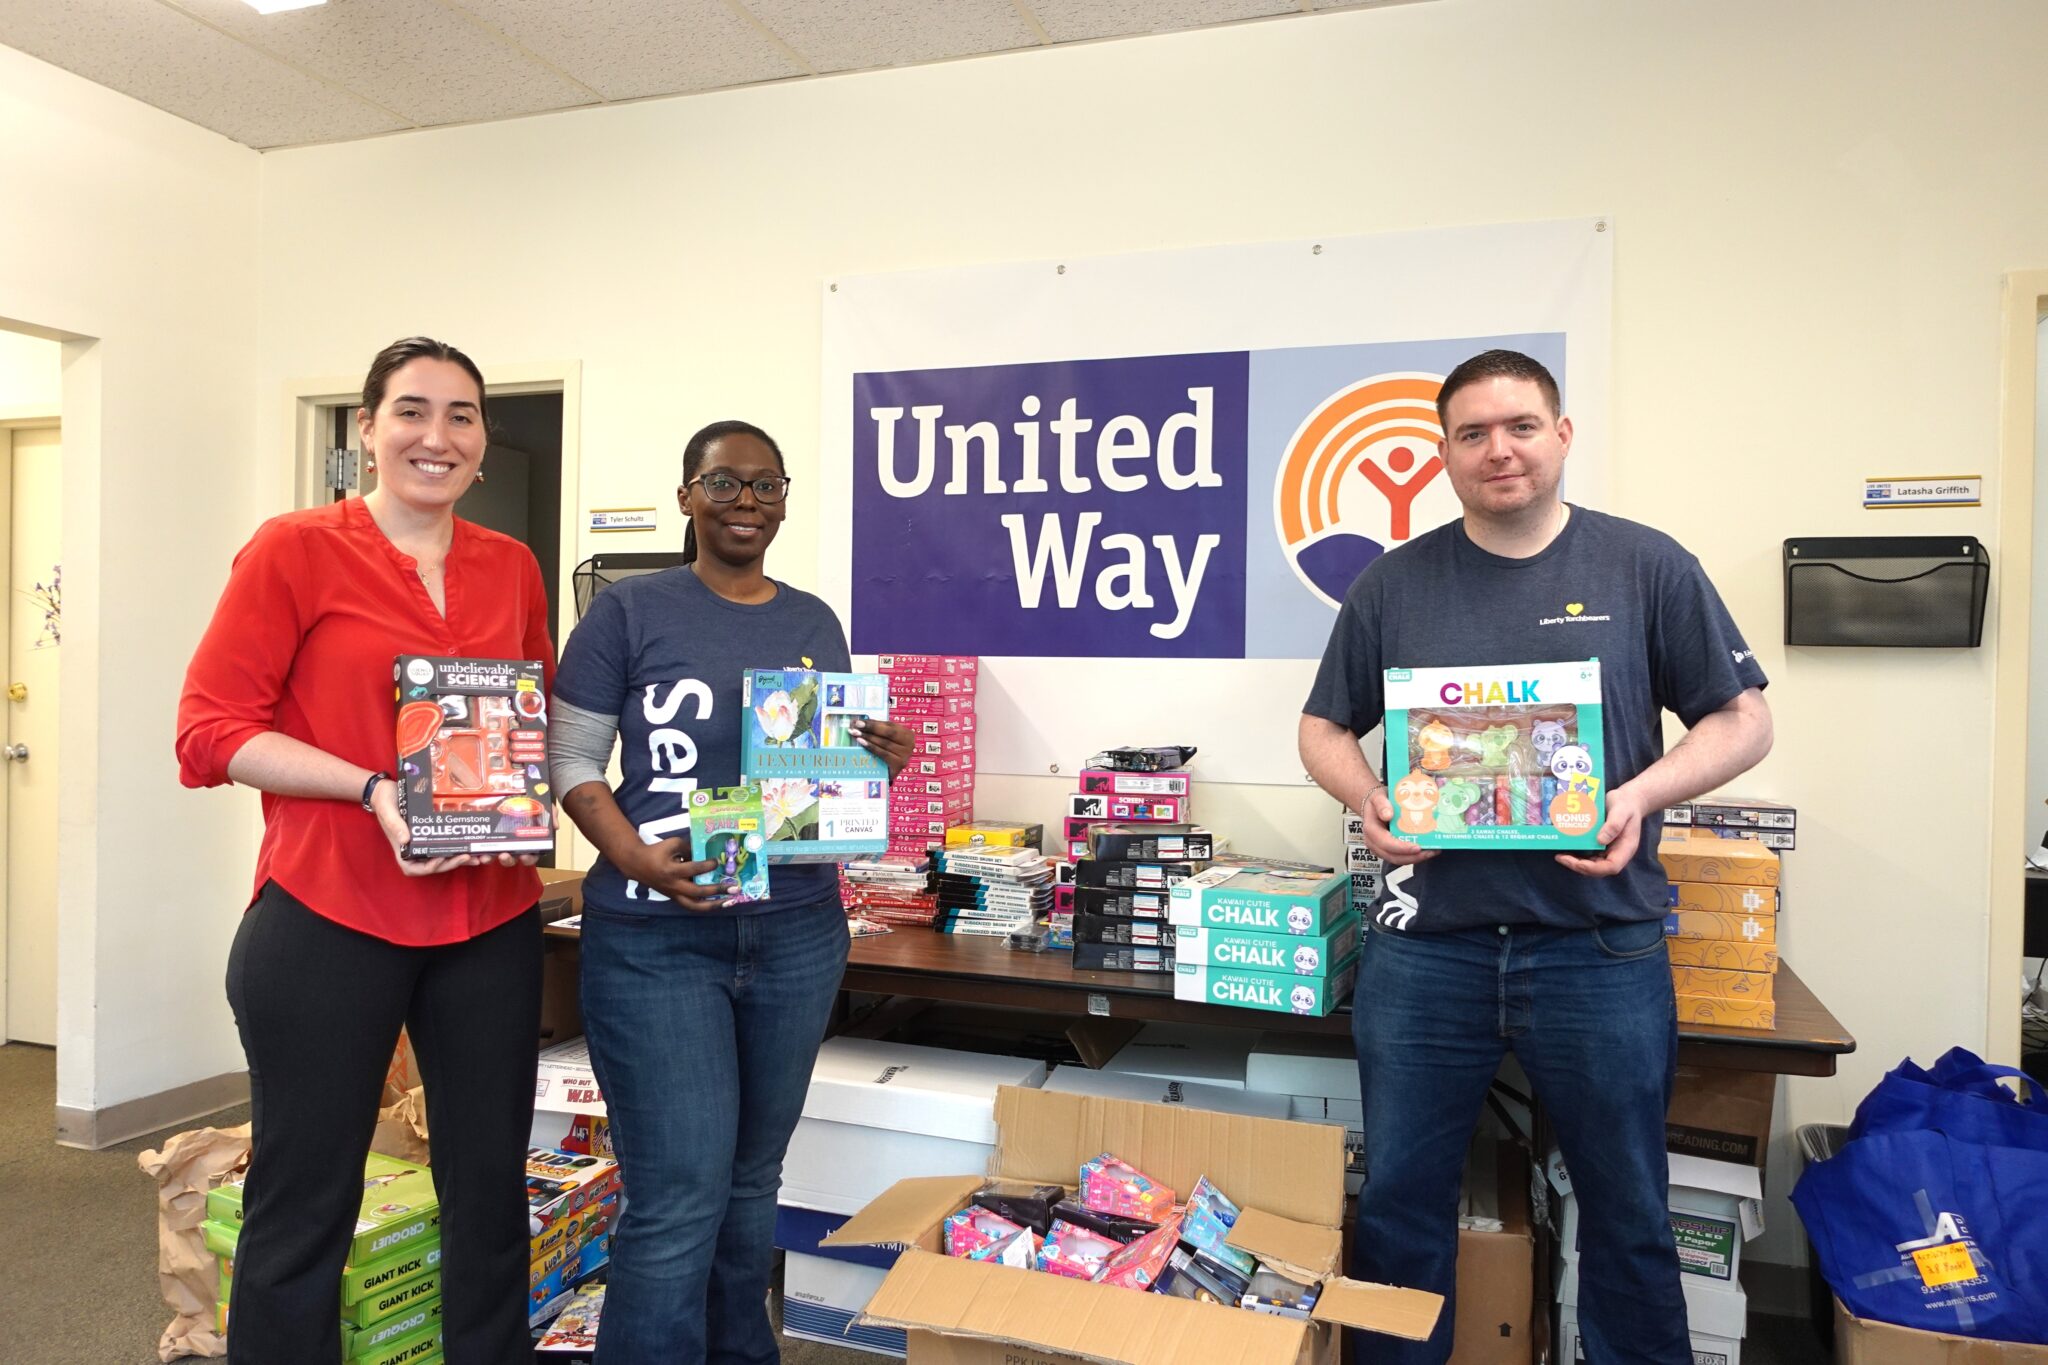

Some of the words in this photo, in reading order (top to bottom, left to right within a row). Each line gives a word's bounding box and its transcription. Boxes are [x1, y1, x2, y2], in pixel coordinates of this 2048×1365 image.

[870, 385, 1222, 499] United
[1897, 487, 1933, 496] Latasha
[1935, 486, 1970, 495] Griffith
[1001, 511, 1220, 640] Way
[1539, 617, 1565, 625] Liberty
[439, 662, 516, 676] unbelievable
[447, 673, 508, 686] SCIENCE
[1439, 679, 1541, 705] CHALK
[757, 753, 846, 769] TEXTURED
[850, 754, 878, 769] ART
[626, 678, 714, 901] Serv
[1074, 797, 1102, 816] MTV
[1566, 794, 1581, 813] 5
[412, 815, 434, 824] Rock
[435, 816, 443, 824] &
[445, 815, 491, 823] Gemstone
[1555, 813, 1591, 823] BONUS
[411, 825, 491, 836] COLLECTION
[825, 820, 834, 838] 1
[840, 818, 879, 826] PRINTED
[1352, 854, 1379, 862] WARS
[1217, 897, 1245, 905] KAWAII
[1246, 899, 1271, 908] CUTIE
[1207, 904, 1280, 927] CHALK
[1223, 937, 1251, 945] KAWAII
[1252, 939, 1278, 948] CUTIE
[1214, 943, 1286, 967] CHALK
[1221, 974, 1249, 984] KAWAII
[1250, 977, 1275, 987] CUTIE
[1212, 981, 1283, 1006] CHALK
[1668, 1131, 1748, 1155] READING.COM
[1670, 1218, 1729, 1234] AGSHIP
[370, 1221, 426, 1252] CROQUET
[1684, 1235, 1717, 1247] Paper
[364, 1268, 395, 1289] GIANT
[397, 1259, 421, 1276] KICK
[379, 1290, 409, 1311] GIANT
[411, 1280, 434, 1297] KICK
[368, 1312, 426, 1346] CROQUET
[411, 1338, 434, 1356] KICK
